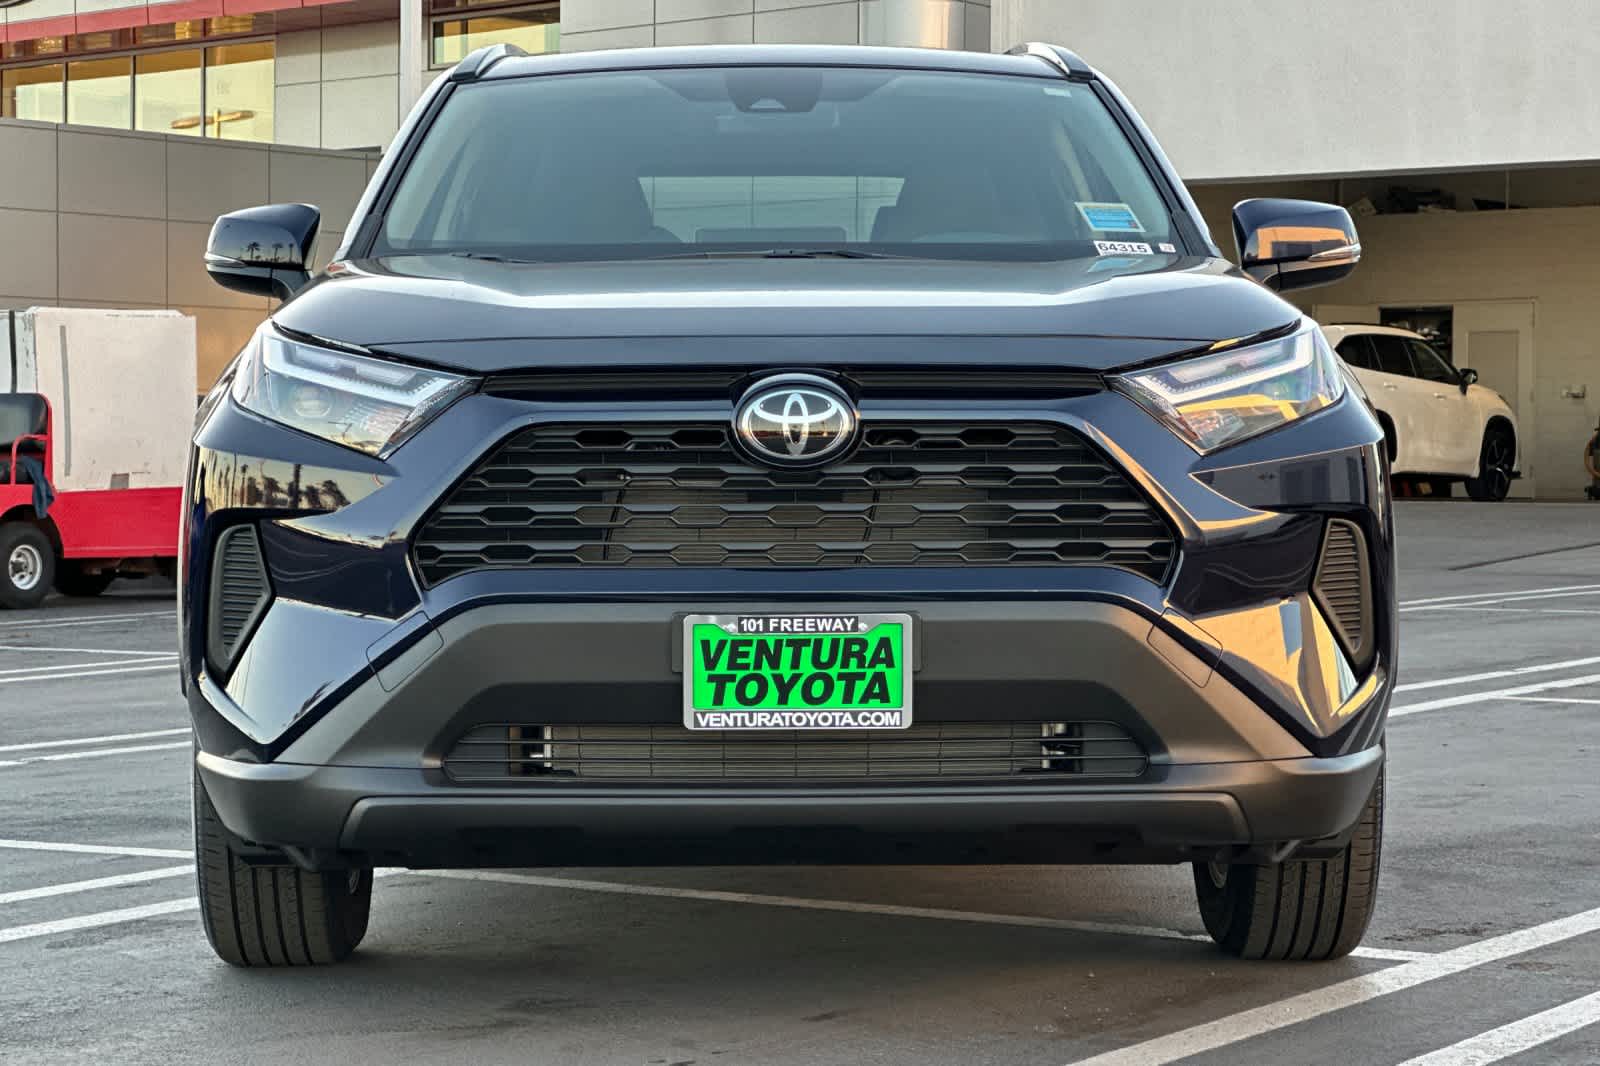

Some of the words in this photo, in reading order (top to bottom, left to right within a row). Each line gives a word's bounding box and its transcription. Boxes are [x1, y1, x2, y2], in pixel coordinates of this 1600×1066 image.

[1097, 243, 1148, 253] 64315
[741, 619, 763, 631] 101
[770, 618, 855, 631] FREEWAY
[700, 637, 896, 670] VENTURA
[707, 672, 890, 706] TOYOTA
[697, 712, 900, 726] VENTURATOYOTA.COM
